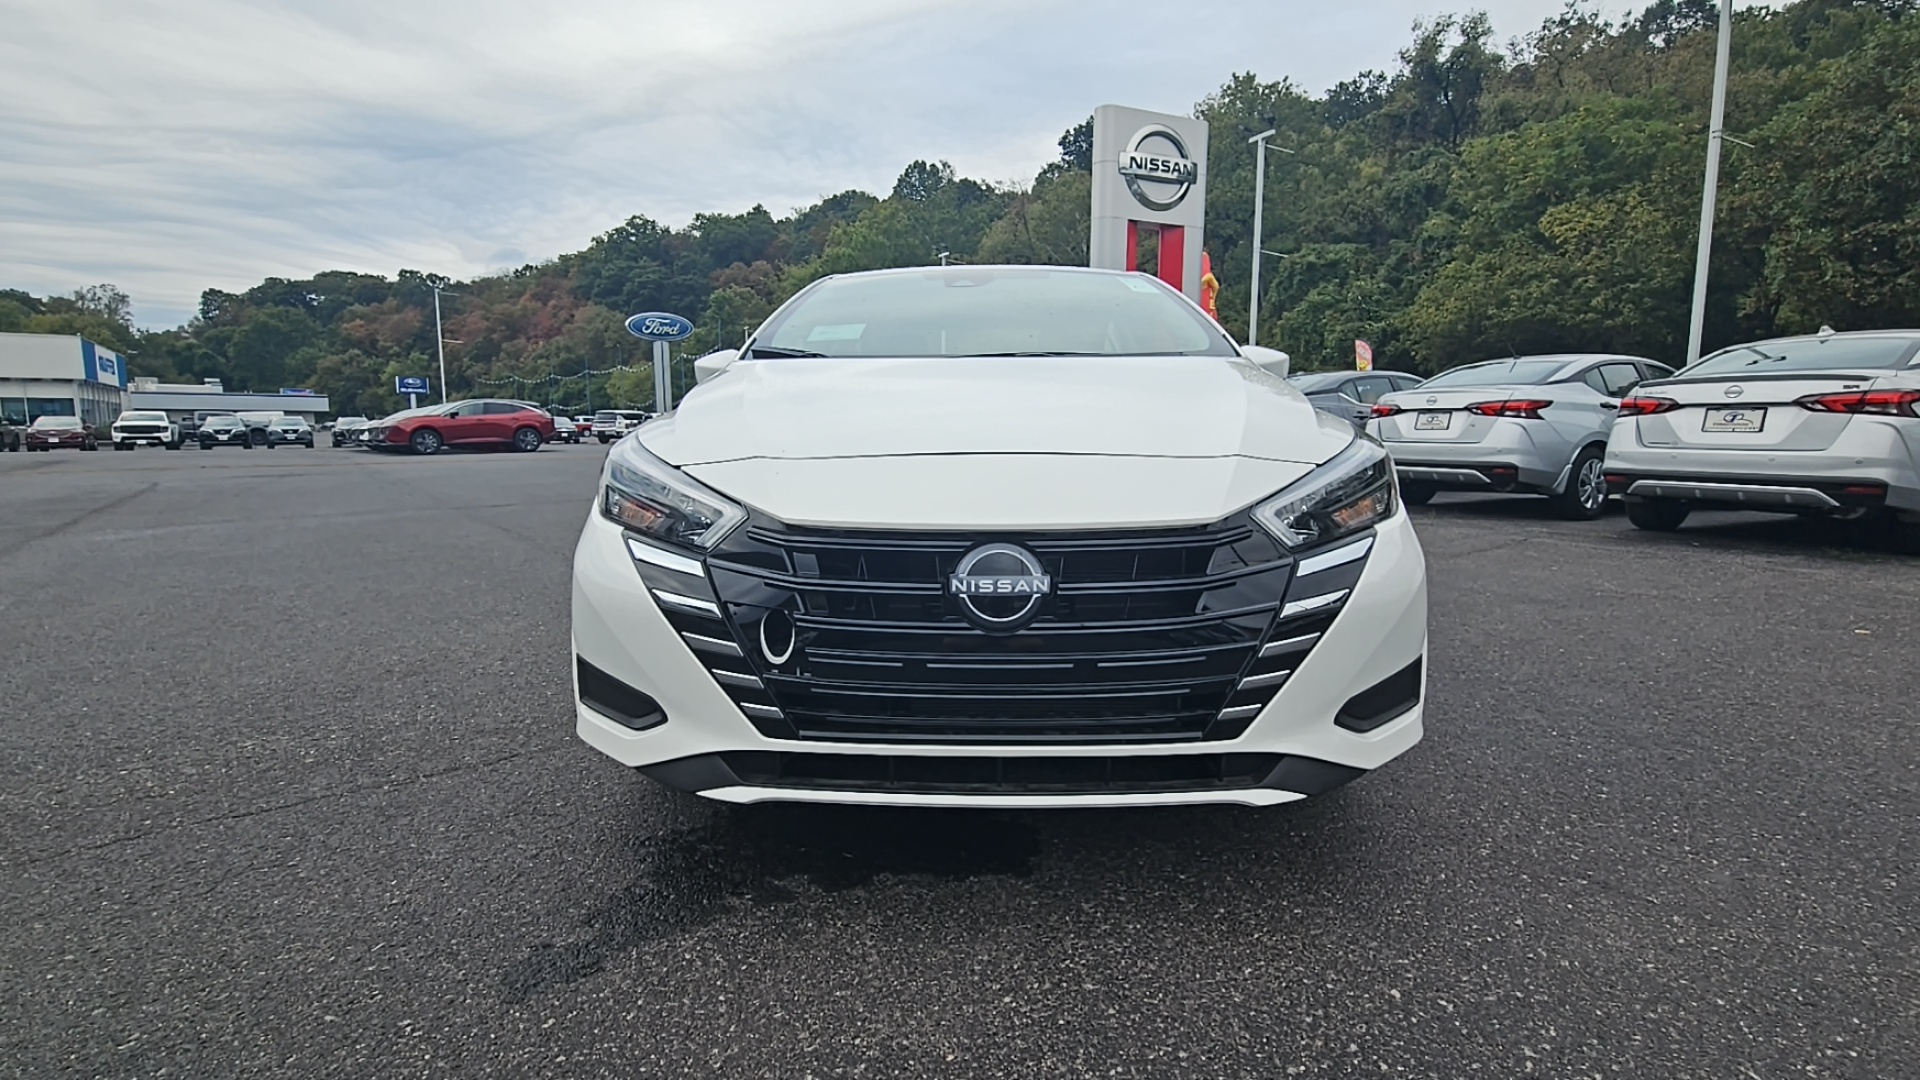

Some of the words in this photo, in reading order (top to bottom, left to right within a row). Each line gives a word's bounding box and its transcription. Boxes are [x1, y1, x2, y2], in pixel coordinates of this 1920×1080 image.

[1129, 156, 1193, 177] NISSAN
[642, 318, 681, 335] Ford
[951, 578, 1049, 593] NISSAN
